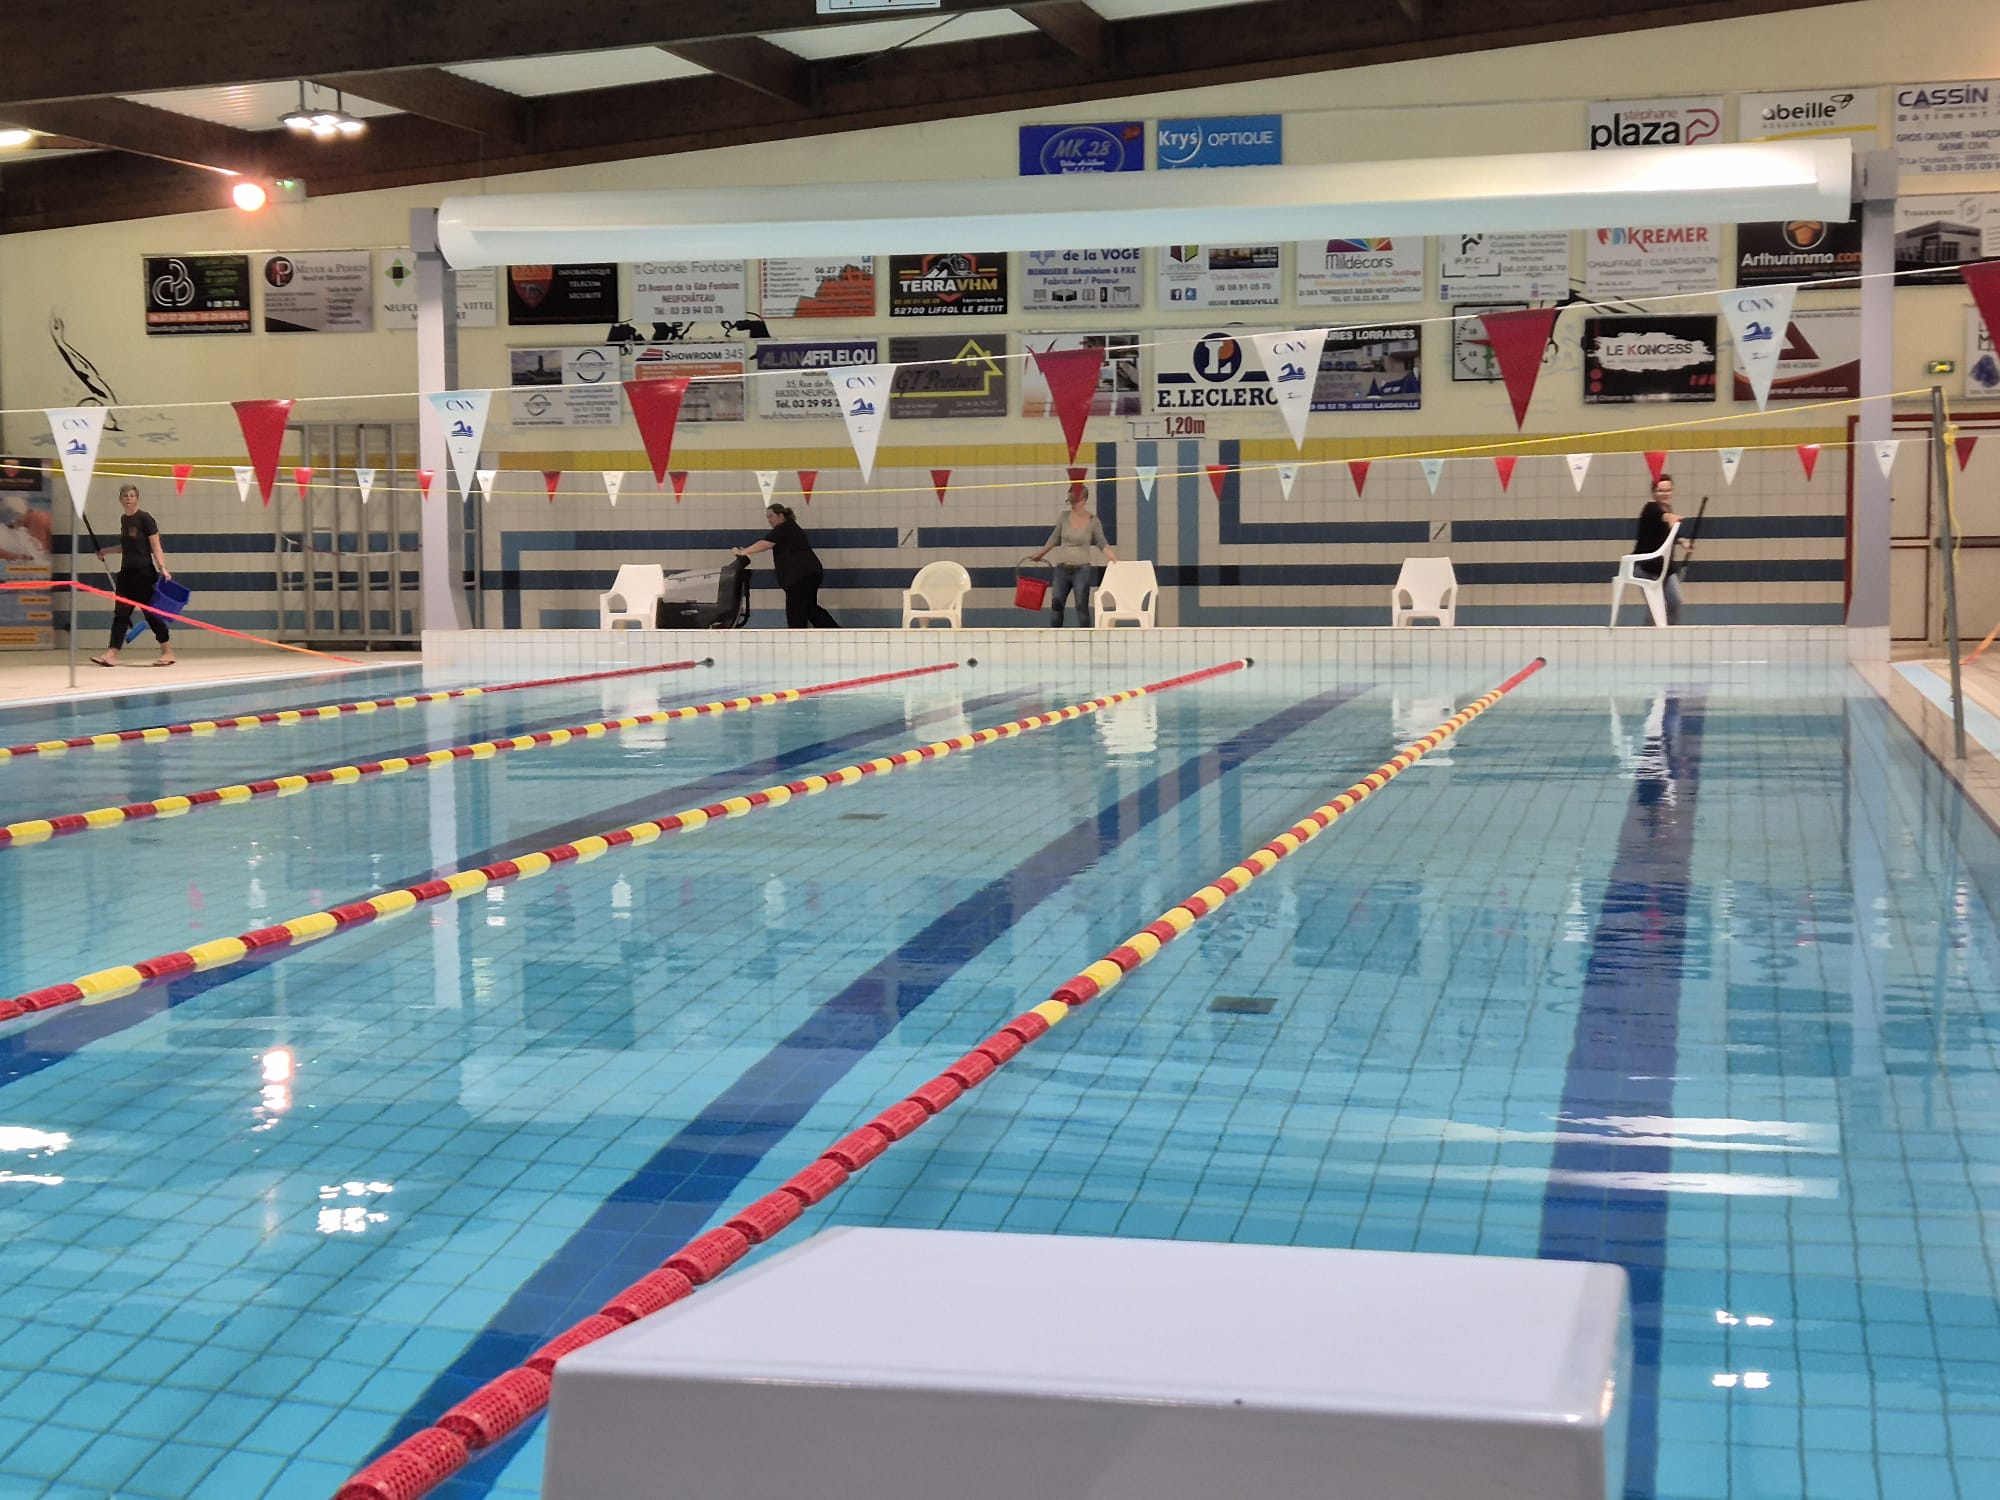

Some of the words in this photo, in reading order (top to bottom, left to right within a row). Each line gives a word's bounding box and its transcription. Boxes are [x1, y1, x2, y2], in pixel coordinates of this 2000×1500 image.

[1761, 102, 1837, 120] abeille
[1207, 130, 1273, 146] OPTIQUE
[1590, 113, 1680, 150] plaza
[1052, 139, 1085, 158] MK
[1086, 140, 1112, 157] 28
[1628, 227, 1709, 253] KREMER
[1062, 250, 1080, 261] de
[1084, 249, 1097, 260] la
[1100, 248, 1140, 260] VOGE
[1325, 253, 1393, 270] Mildécors
[642, 262, 687, 275] Grande
[691, 260, 744, 273] Fontaine
[899, 278, 998, 293] TERRAVHM
[463, 301, 495, 310] VITTEL
[1737, 298, 1775, 313] CNN
[1356, 329, 1416, 340] LORRAINES
[664, 350, 722, 361] SHOWROOM
[724, 348, 744, 360] 345
[1606, 344, 1624, 356] LE
[1627, 342, 1694, 356] KONCESS
[761, 351, 803, 367] ALAIN
[801, 348, 876, 367] AFFLELOU
[1157, 386, 1278, 408] E.LECLERC
[1164, 415, 1206, 438] 1,20m
